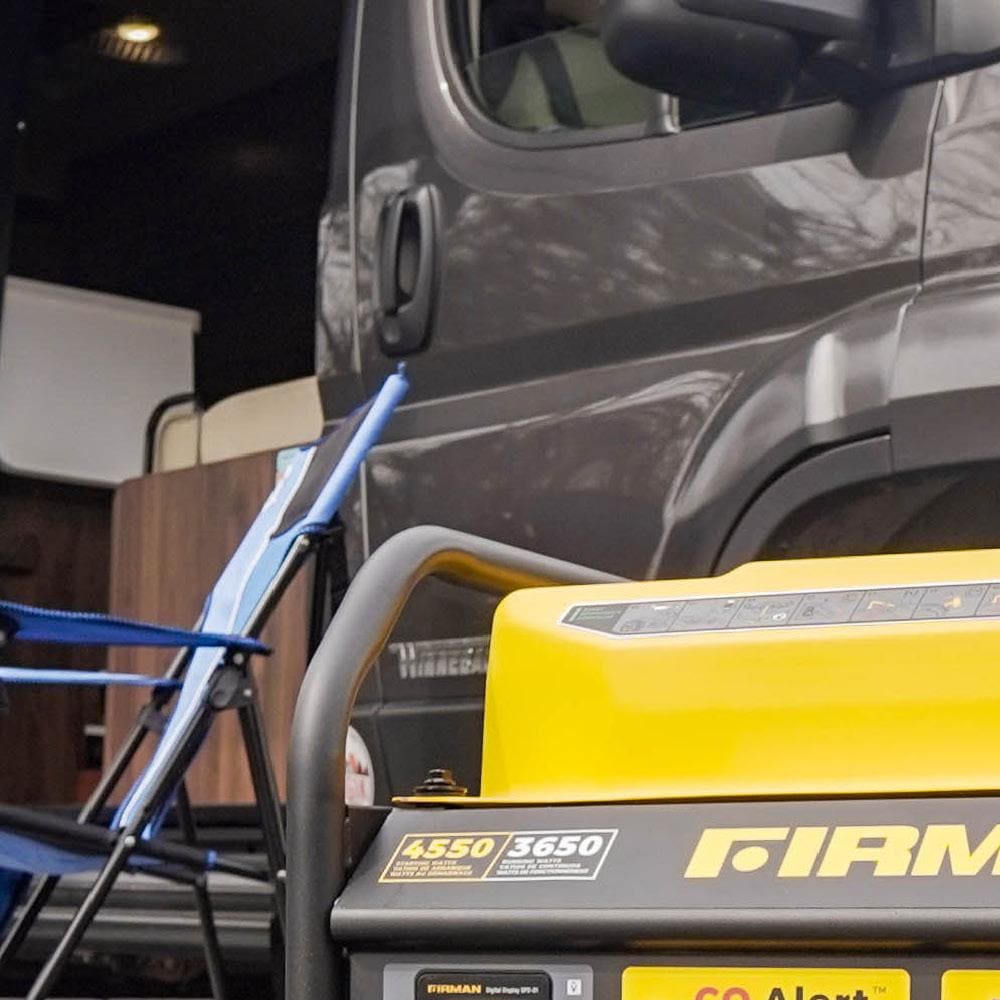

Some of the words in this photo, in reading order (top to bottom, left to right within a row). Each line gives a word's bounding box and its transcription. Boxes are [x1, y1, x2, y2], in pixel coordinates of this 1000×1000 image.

[401, 837, 496, 860] 4550
[507, 835, 604, 858] 3650
[427, 984, 482, 994] FIRMAN
